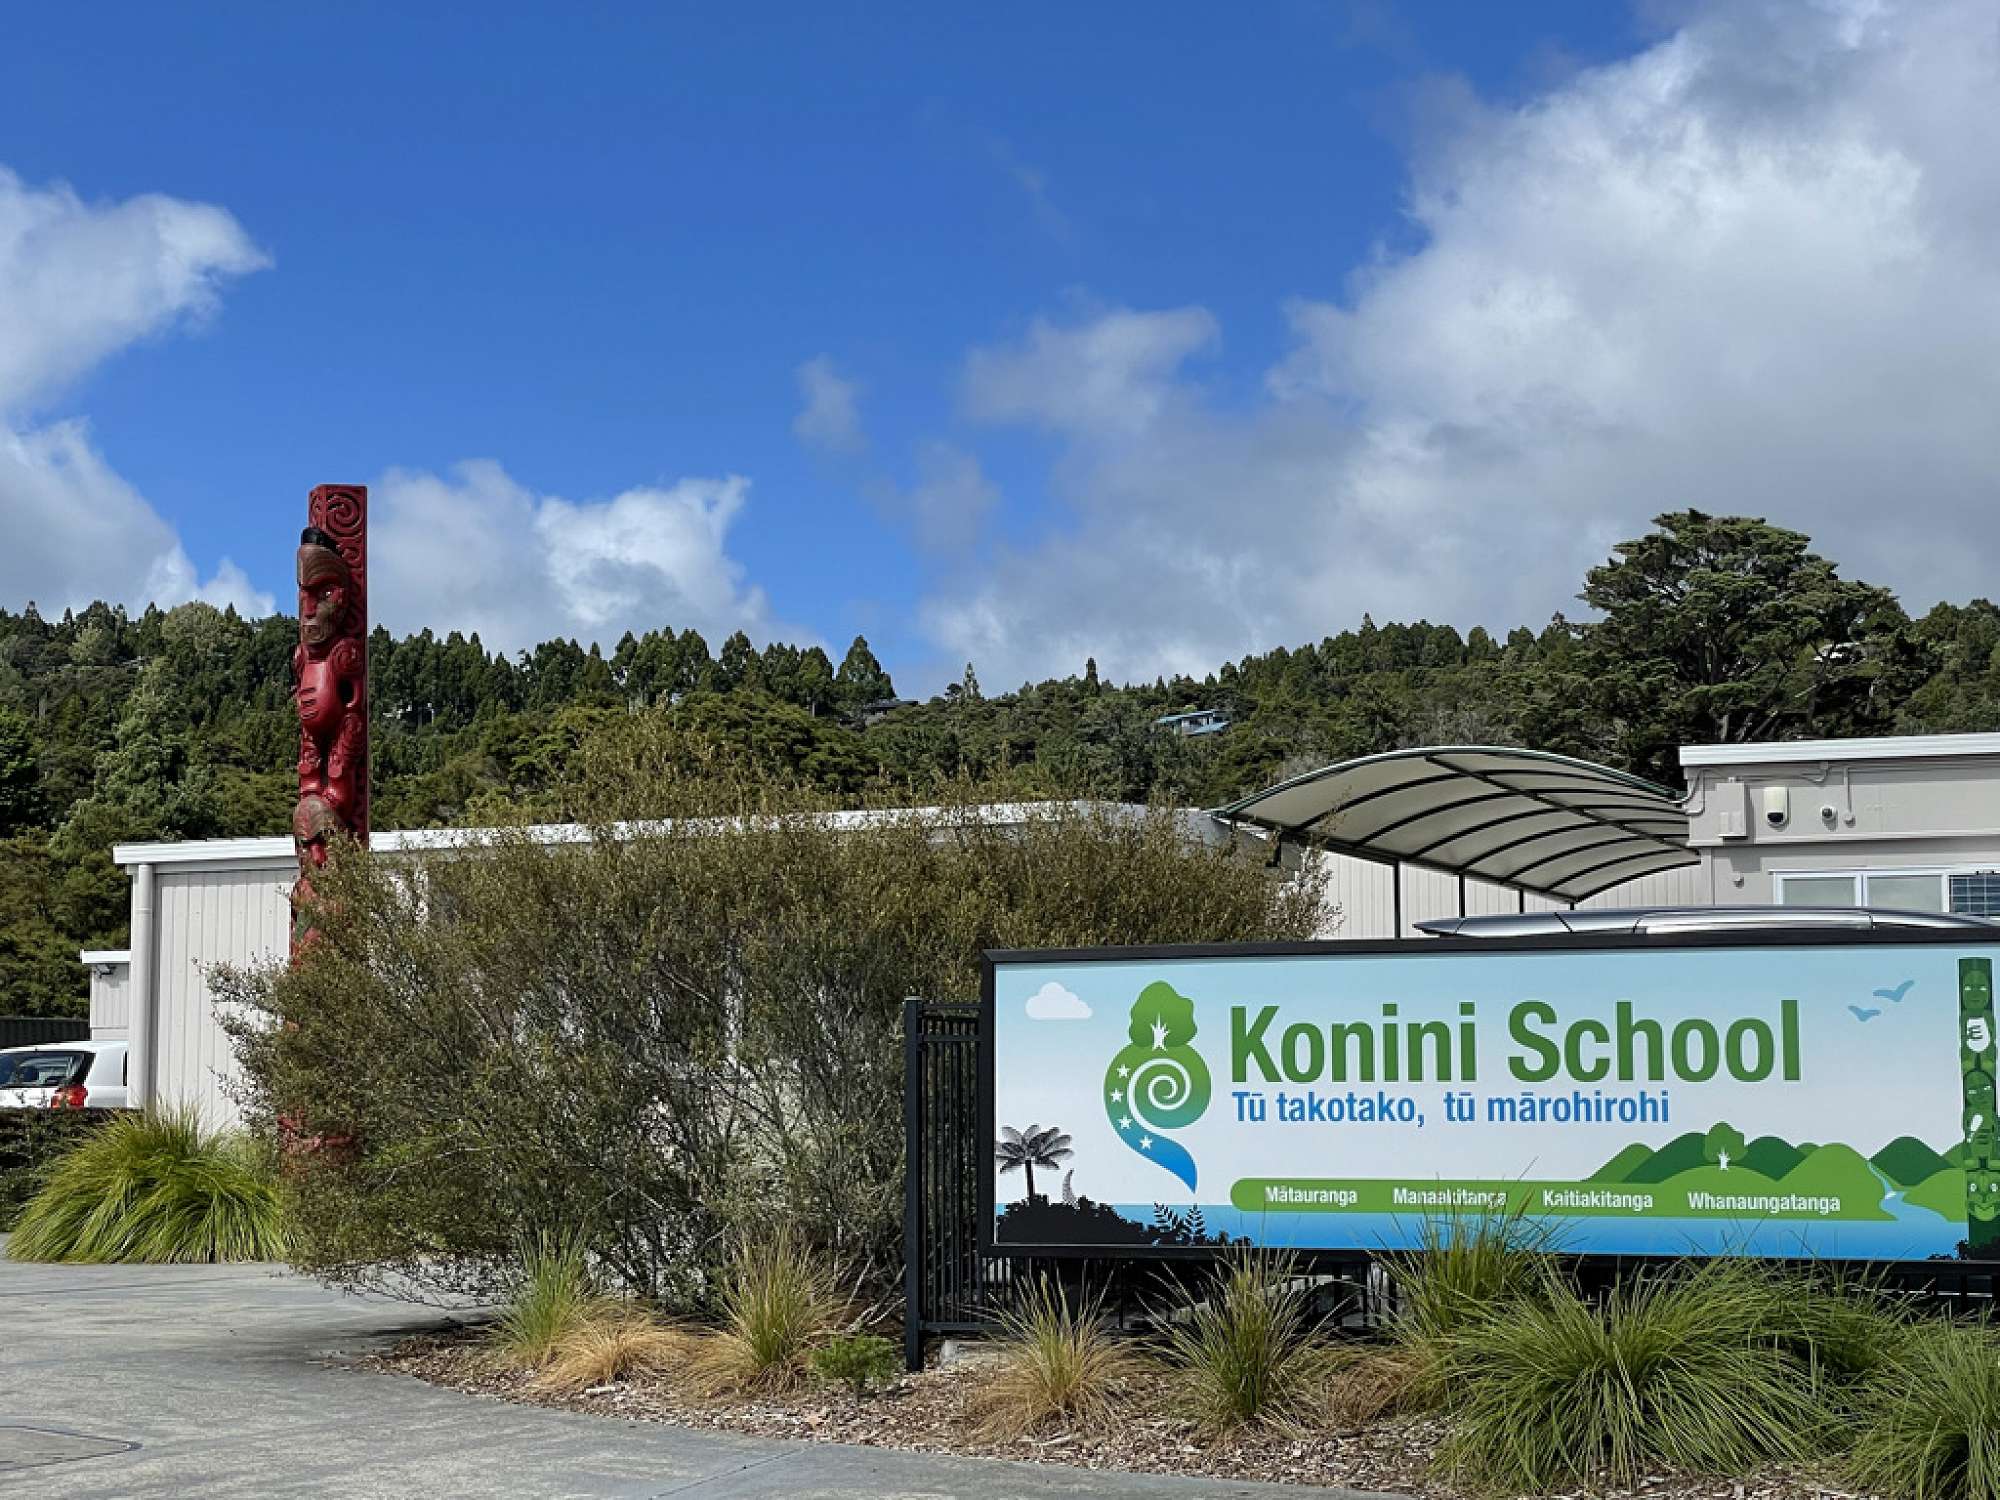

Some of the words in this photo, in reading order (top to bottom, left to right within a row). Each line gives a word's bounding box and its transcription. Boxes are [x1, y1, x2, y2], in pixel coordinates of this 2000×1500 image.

[1230, 1001, 1477, 1083] Konini
[1508, 999, 1801, 1083] School
[1232, 1091, 1266, 1122] Tū
[1276, 1091, 1425, 1127] takotako,
[1444, 1091, 1476, 1122] tū
[1487, 1090, 1670, 1123] mārohirohi
[1542, 1190, 1654, 1211] Kaitiakitanga
[1687, 1192, 1842, 1213] Whanaungatanga
